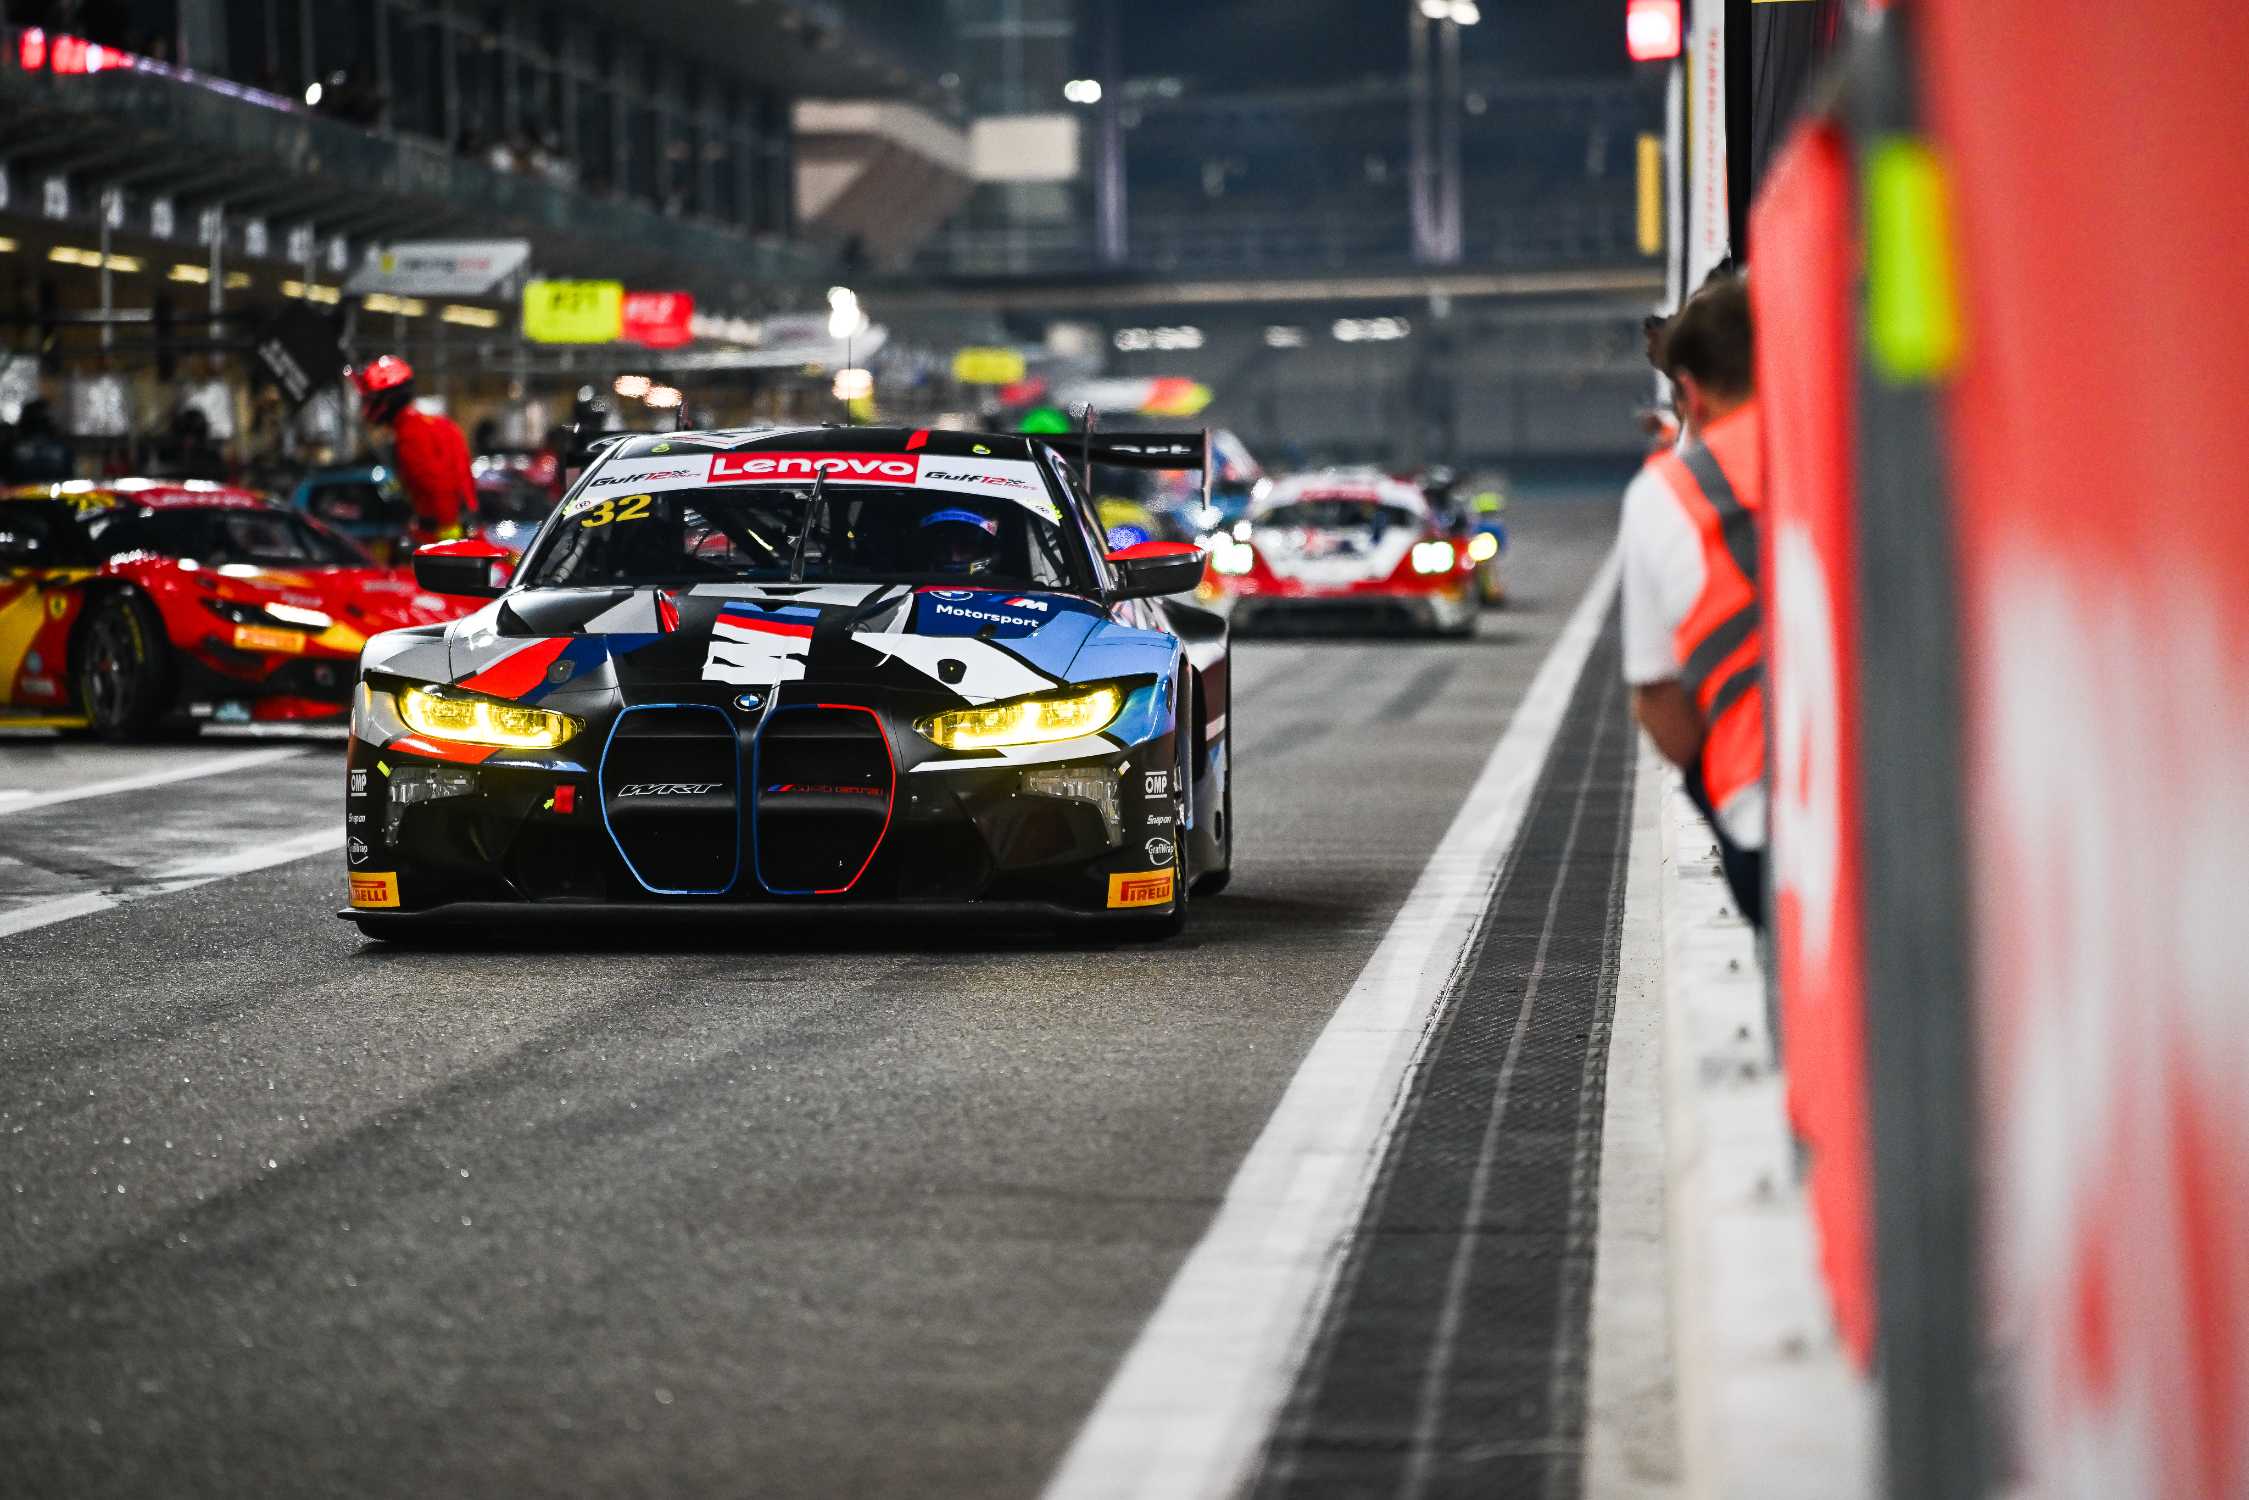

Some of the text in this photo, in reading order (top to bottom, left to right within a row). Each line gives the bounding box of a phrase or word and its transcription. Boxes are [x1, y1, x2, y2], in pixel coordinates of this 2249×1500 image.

[712, 457, 915, 477] Lenovo
[580, 494, 653, 528] 32
[935, 603, 1040, 628] Motorsport
[350, 774, 368, 793] OMP
[618, 783, 723, 797] WRT
[1144, 775, 1168, 794] OMP
[1120, 877, 1171, 901] PIRELLI
